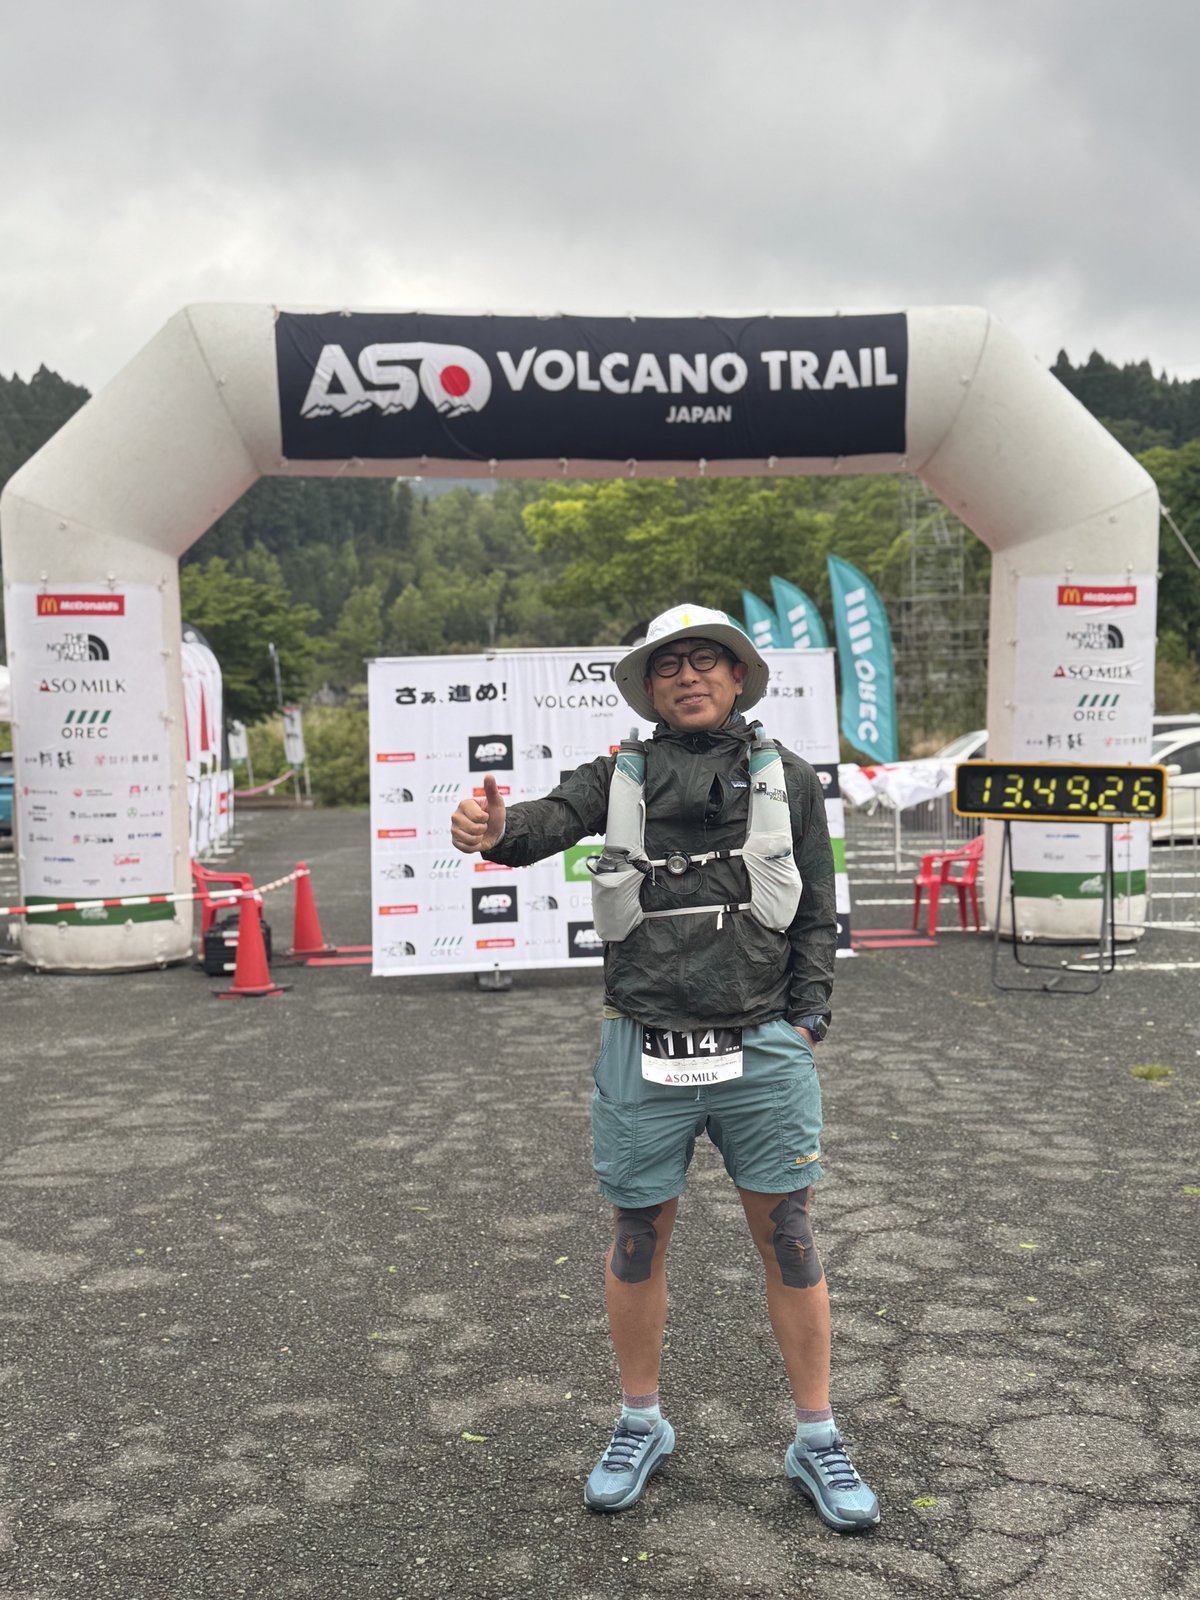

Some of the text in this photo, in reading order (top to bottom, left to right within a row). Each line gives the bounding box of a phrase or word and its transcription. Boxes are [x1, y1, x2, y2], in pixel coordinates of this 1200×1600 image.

[300, 341, 898, 418] ASO VOLCANO TRAIL
[665, 404, 733, 424] JAPAN
[81, 679, 126, 693] MILK
[534, 694, 618, 709] VOLCANO
[854, 659, 879, 744] OREC
[1074, 710, 1117, 721] OREC
[61, 727, 108, 739] OREC
[982, 773, 1156, 811] 13.49.26
[663, 1029, 718, 1056] 114
[692, 1072, 718, 1082] MILK
